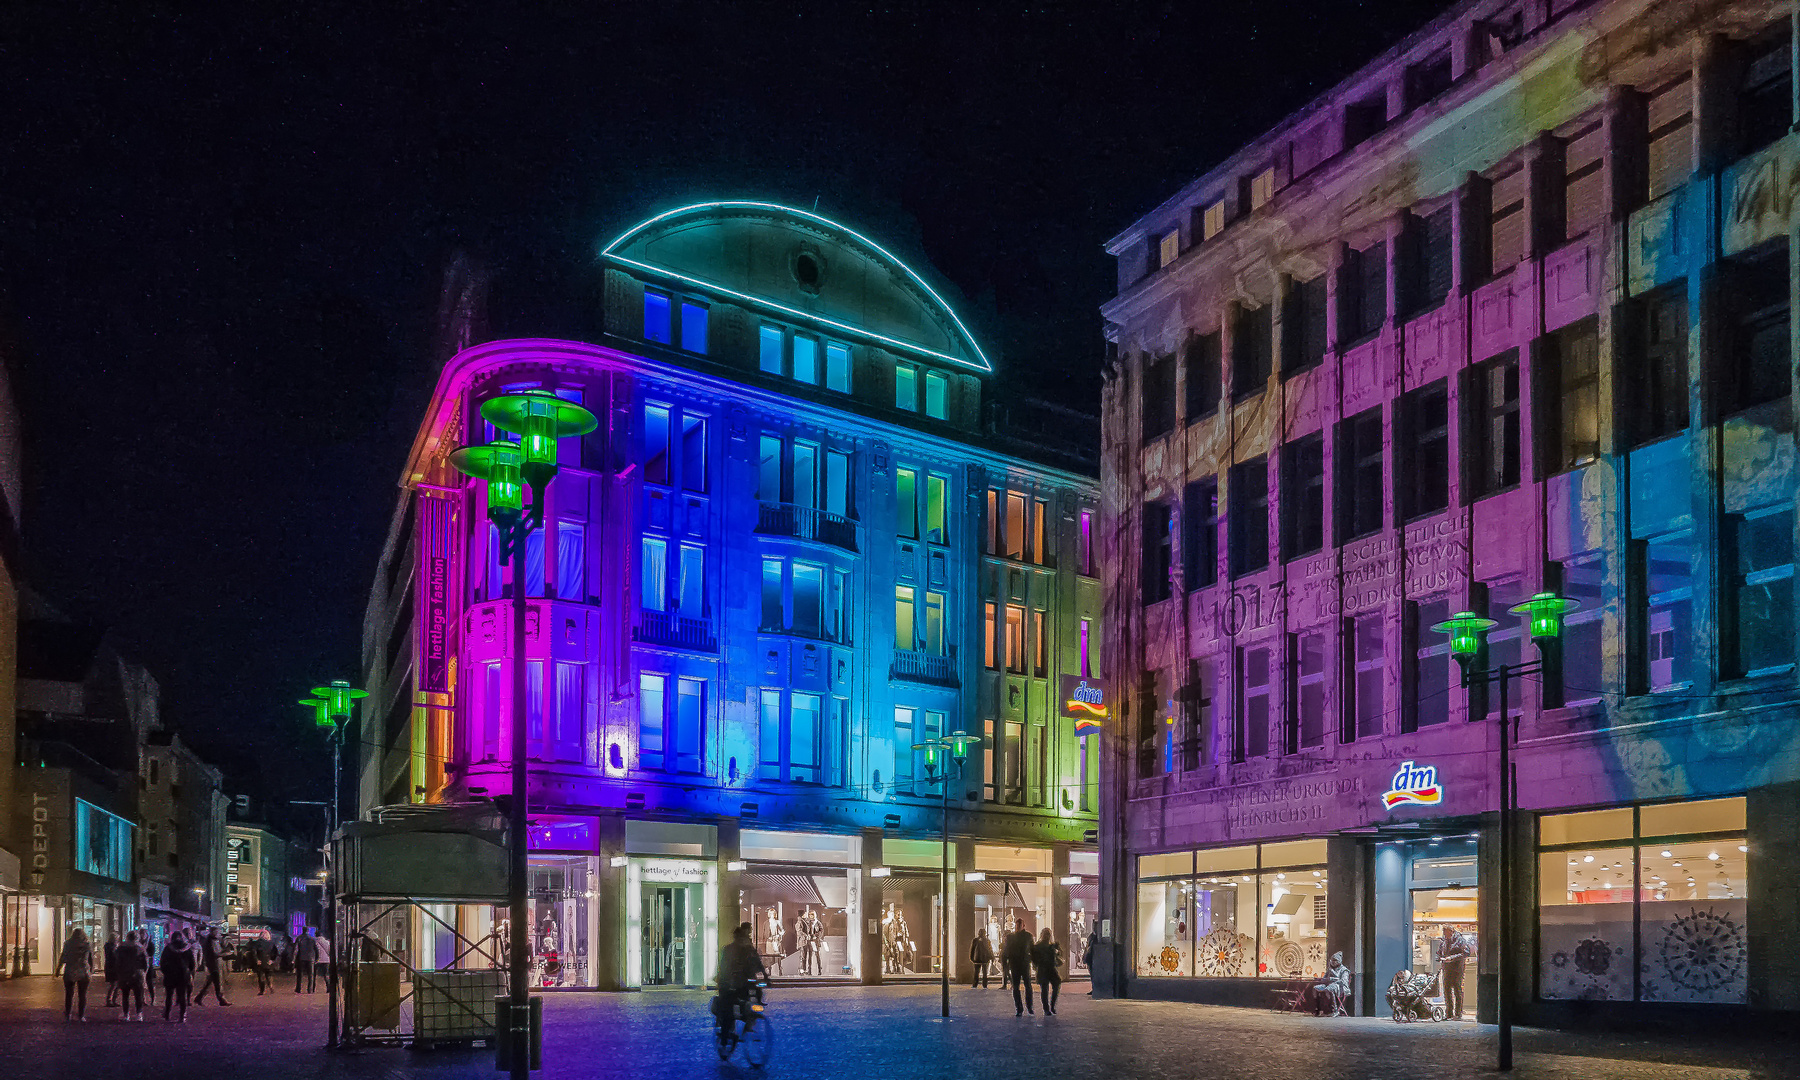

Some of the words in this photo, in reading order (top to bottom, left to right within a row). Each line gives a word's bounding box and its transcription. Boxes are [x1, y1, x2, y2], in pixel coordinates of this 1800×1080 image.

[430, 559, 444, 604] fashion
[1208, 581, 1285, 641] 1017
[429, 608, 446, 660] hettlage
[1074, 680, 1103, 704] dm
[1250, 789, 1289, 805] EINER
[1293, 777, 1361, 799] URKUNDE
[1395, 764, 1433, 791] dm
[33, 792, 48, 868] DEPOT
[1230, 807, 1307, 827] HEINRICHS
[641, 866, 672, 876] hettlage
[682, 867, 708, 876] fashion
